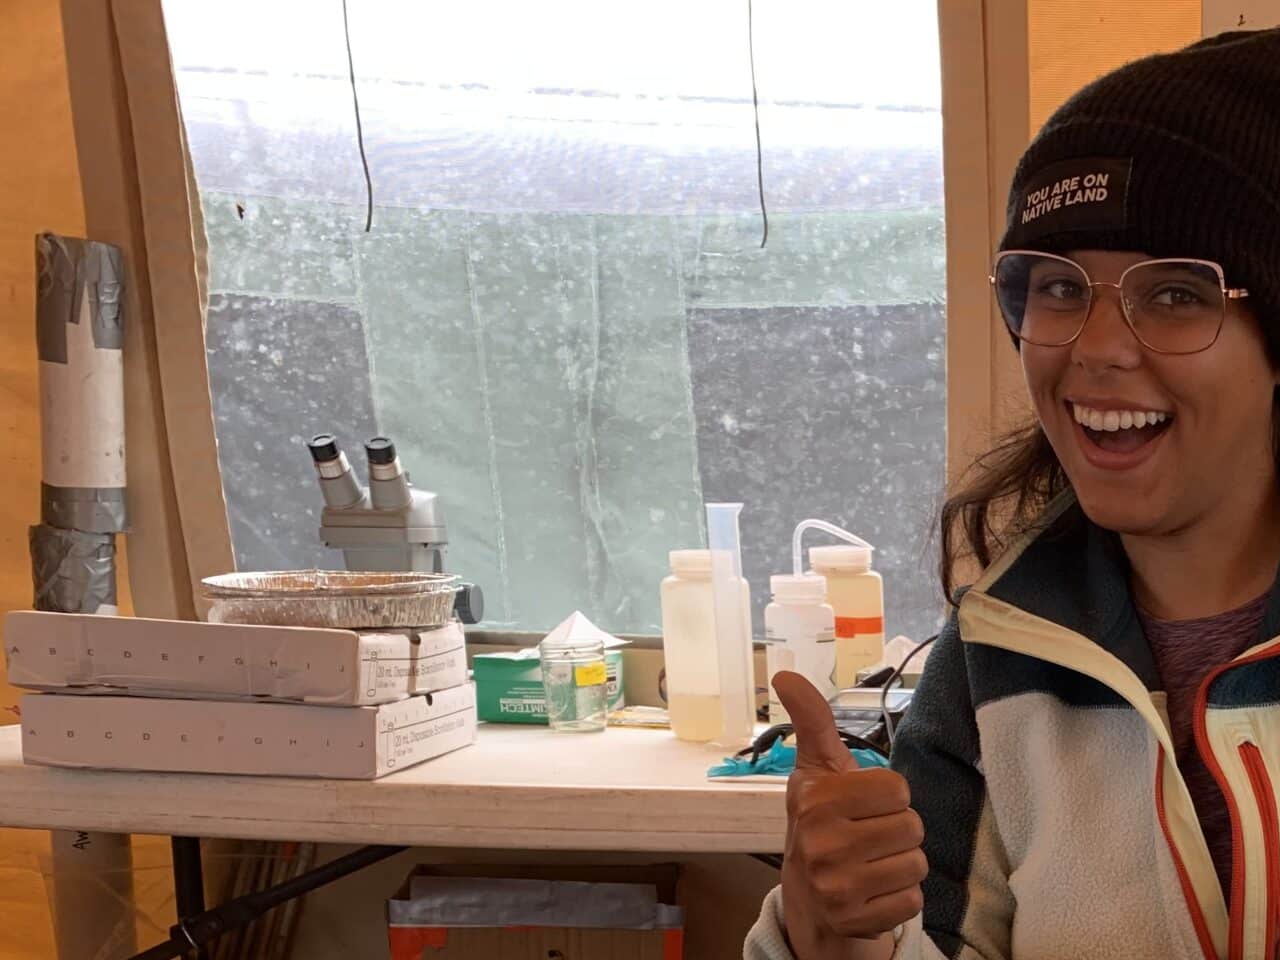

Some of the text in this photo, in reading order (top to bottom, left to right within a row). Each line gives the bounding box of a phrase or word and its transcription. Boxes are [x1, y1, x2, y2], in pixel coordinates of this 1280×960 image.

[1021, 187, 1109, 225] NATIVE LAND
[1026, 173, 1109, 208] YOU ARE ON
